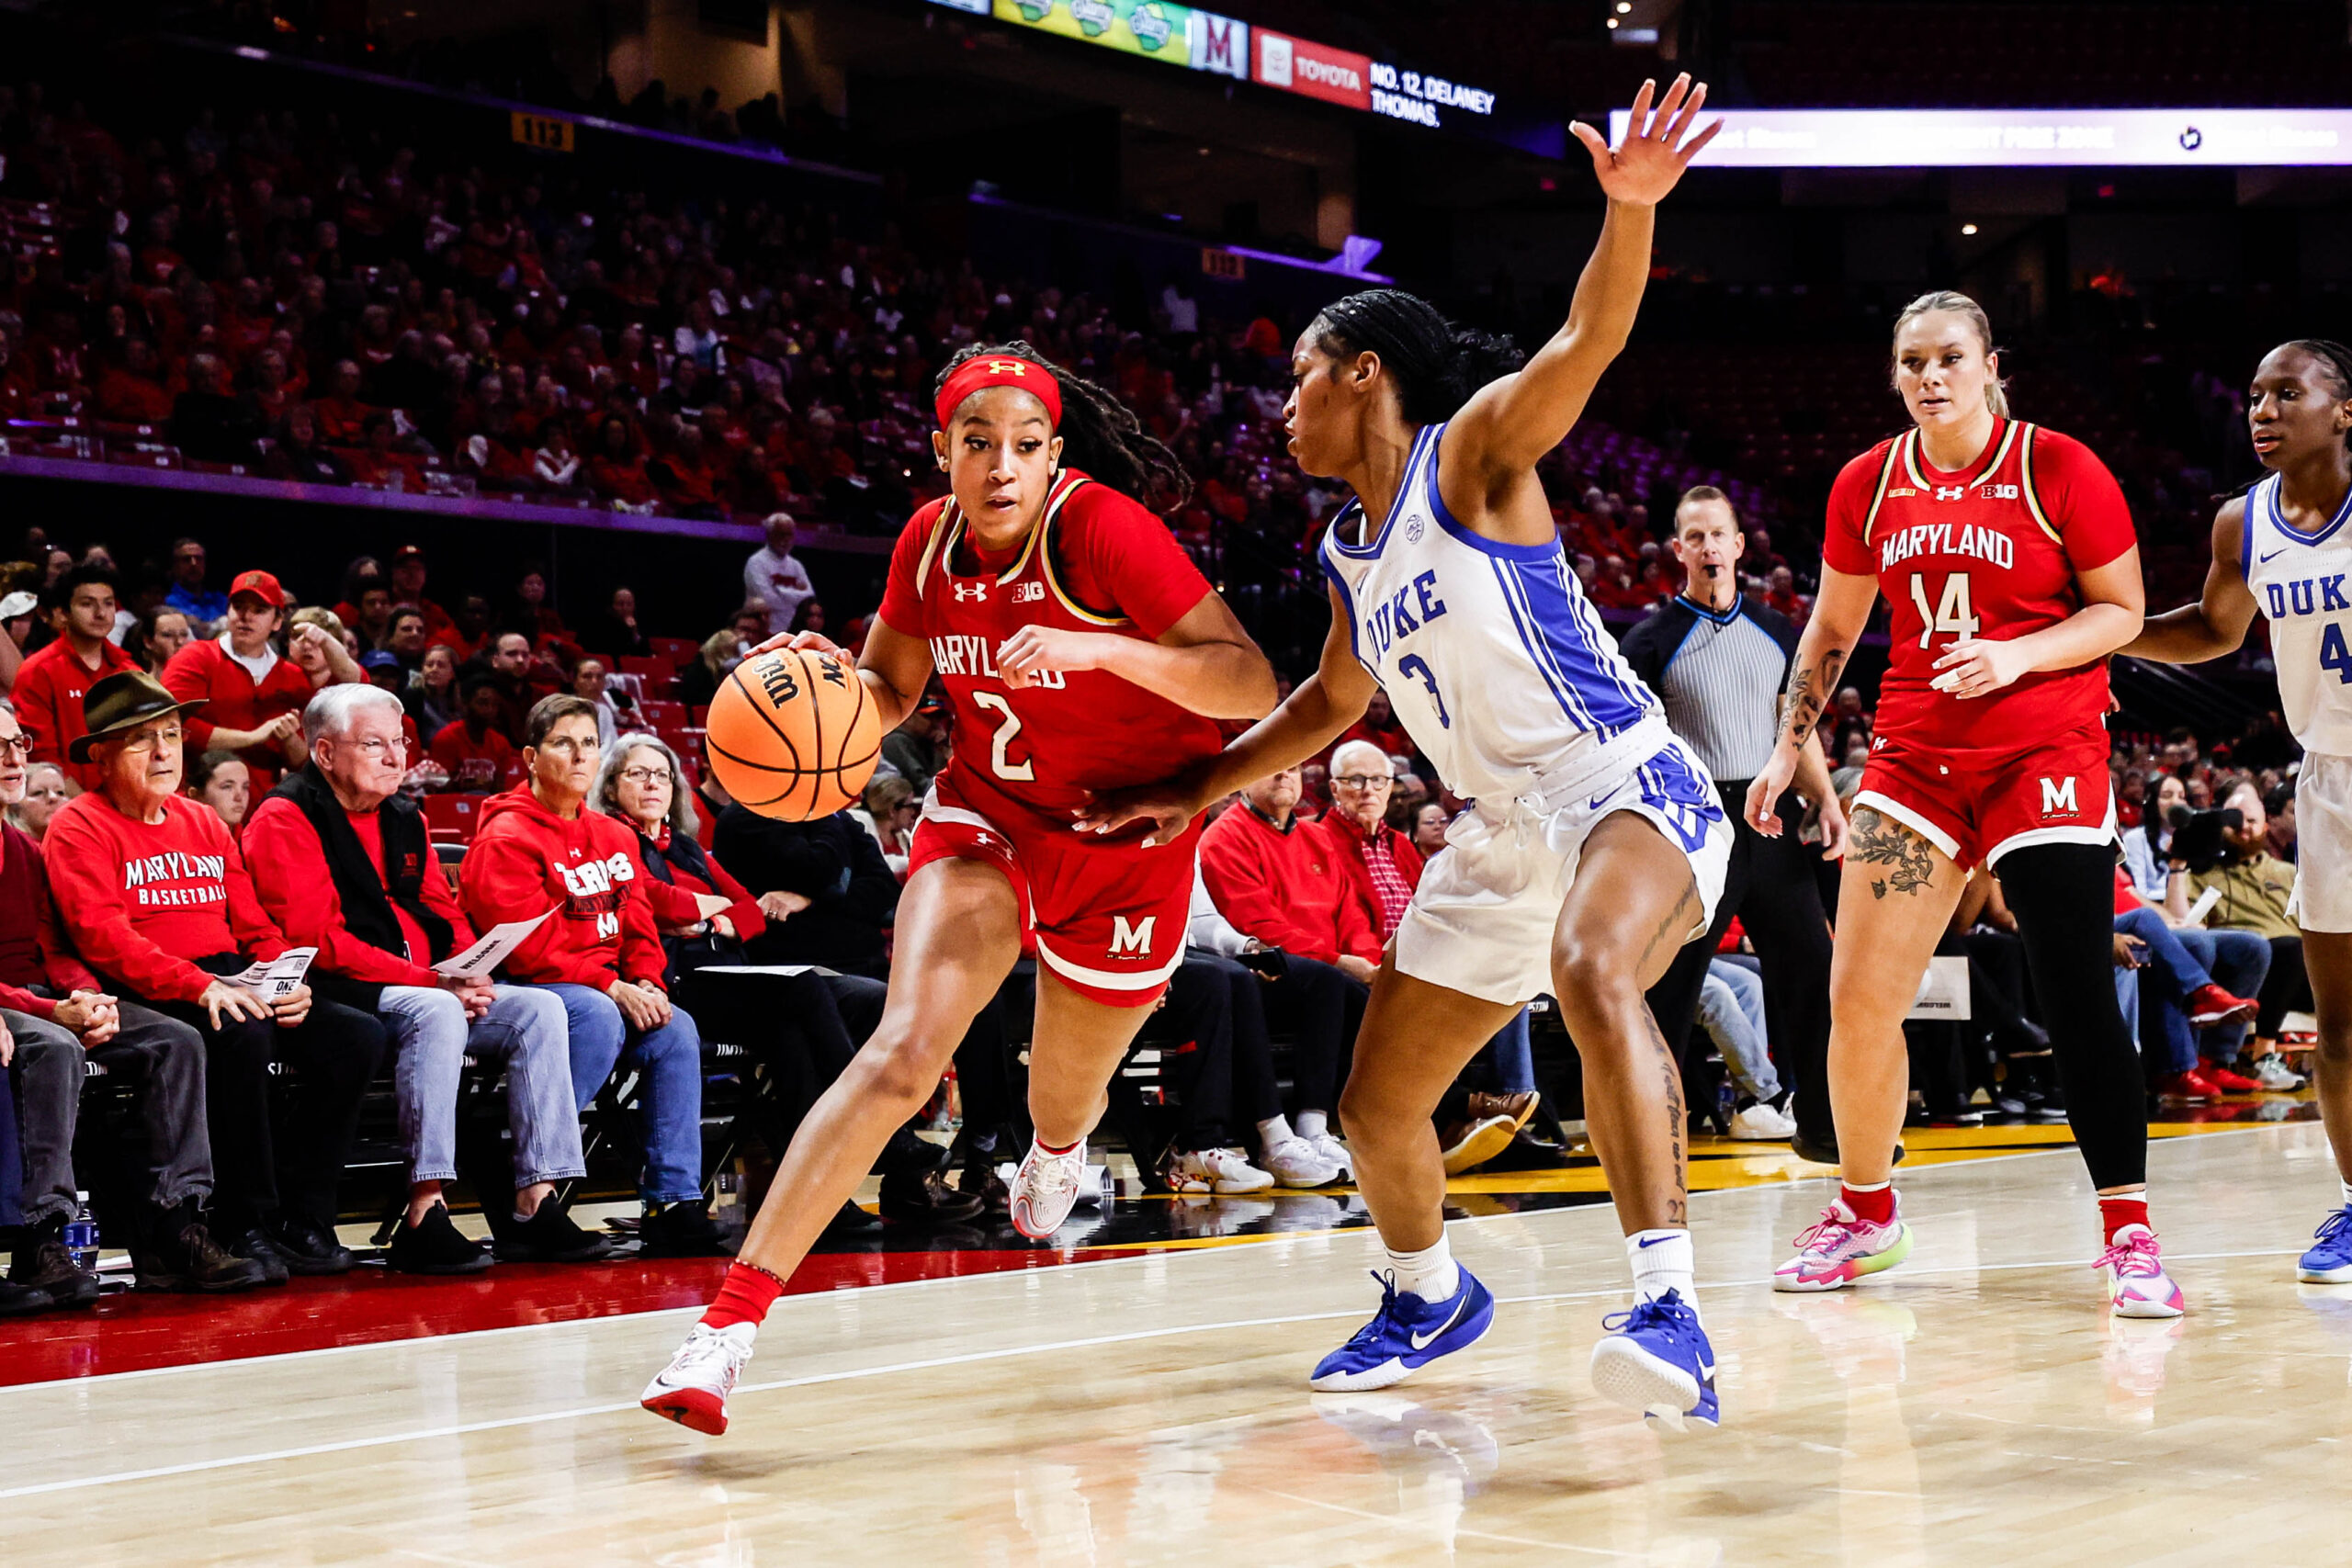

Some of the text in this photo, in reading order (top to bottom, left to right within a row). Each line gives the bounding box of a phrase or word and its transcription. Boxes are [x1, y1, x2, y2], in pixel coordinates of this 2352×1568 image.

[1295, 56, 1361, 91] TOYOTA
[1370, 62, 1399, 91] NO.
[1423, 75, 1495, 115] DELANEY
[1370, 89, 1441, 128] THOMAS.
[523, 118, 562, 147] 113
[1882, 523, 2014, 573] MARYLAND
[1366, 569, 1447, 663] DUKE
[1910, 571, 1980, 649] 14
[2267, 573, 2351, 619] DUK
[2319, 622, 2352, 684] 4
[1398, 653, 1450, 729] 3
[972, 691, 1035, 781] 2
[2039, 775, 2080, 814] M
[596, 911, 619, 939] M
[1107, 915, 1157, 954] M
[459, 939, 502, 970] WELCOME
